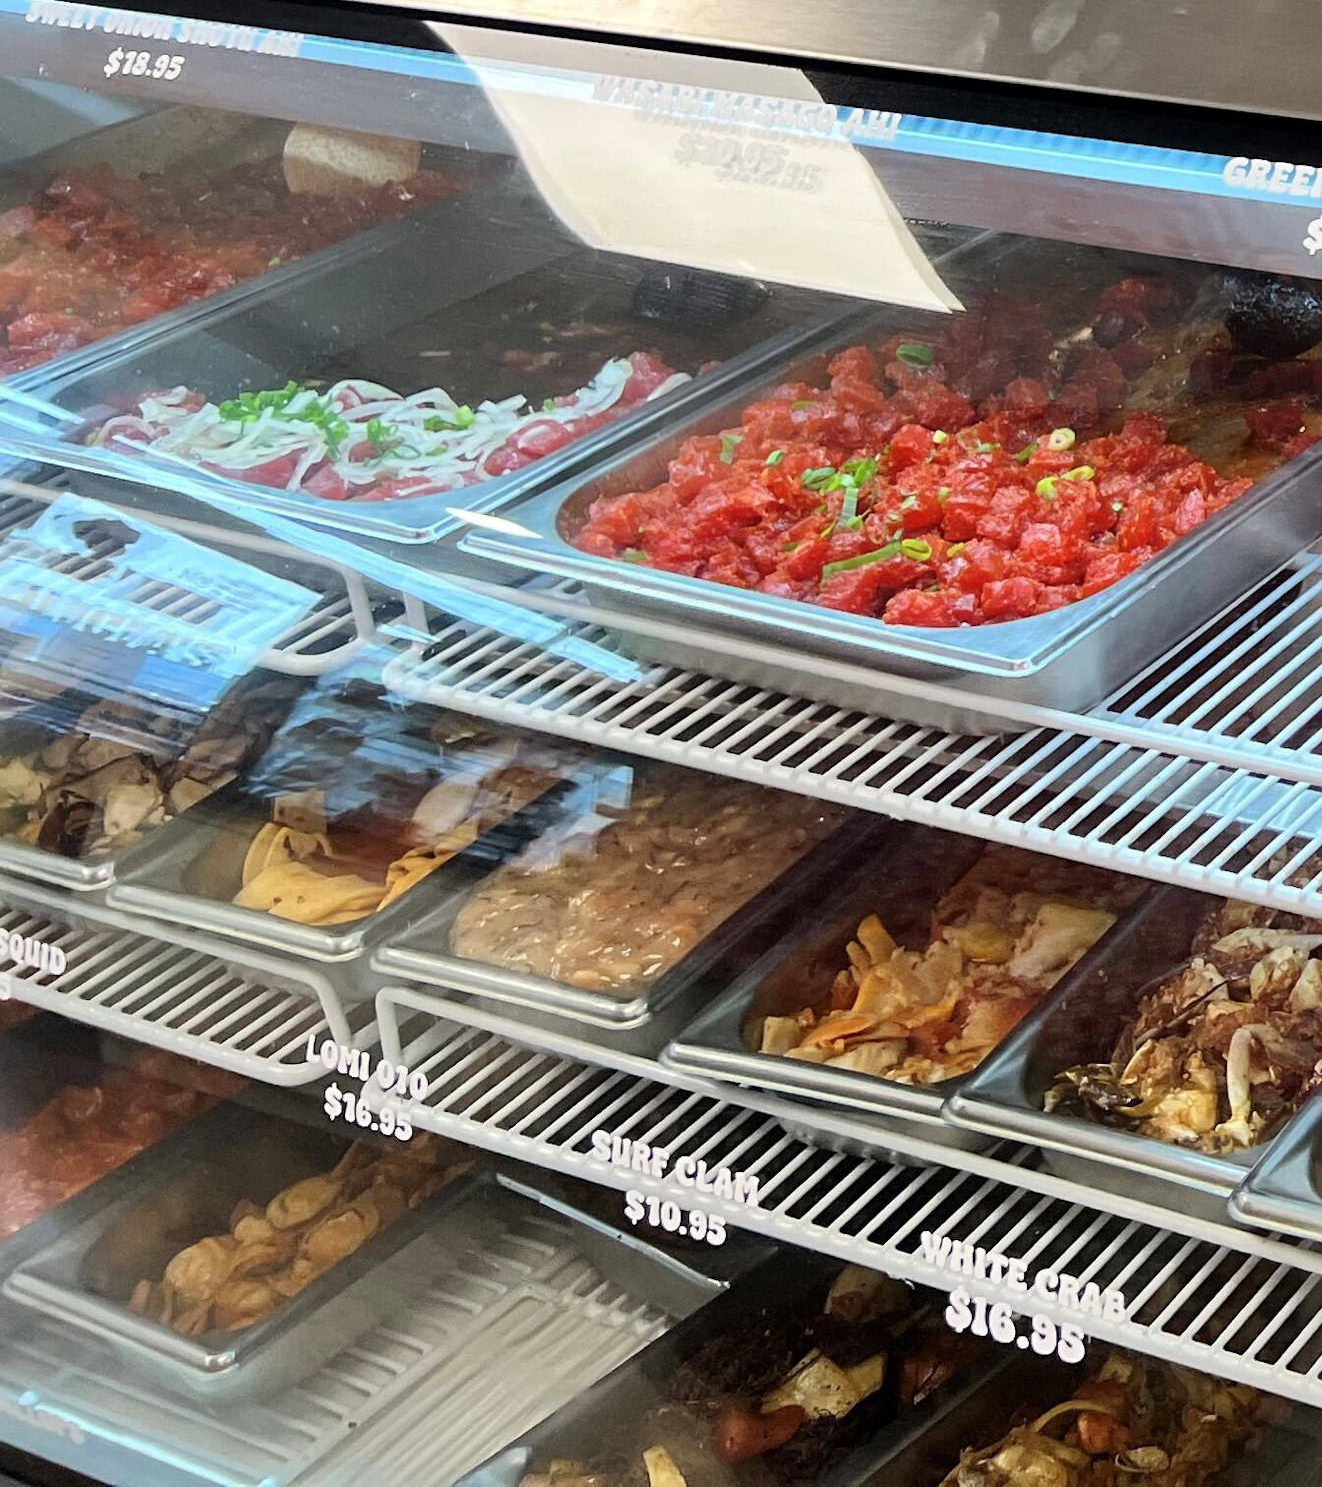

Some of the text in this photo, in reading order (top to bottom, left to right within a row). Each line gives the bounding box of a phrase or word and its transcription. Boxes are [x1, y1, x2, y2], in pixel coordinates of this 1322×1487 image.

[103, 46, 185, 81] $18.95
[841, 107, 903, 142] AHI
[0, 927, 67, 976] SQUID
[305, 1033, 371, 1083] LOMI
[323, 1082, 414, 1141] $16.95
[591, 1129, 760, 1207] SURF CLAM
[624, 1190, 727, 1246] $10.95
[920, 1230, 1126, 1323] WHITE CRAB
[944, 1286, 1086, 1364] $16.95
